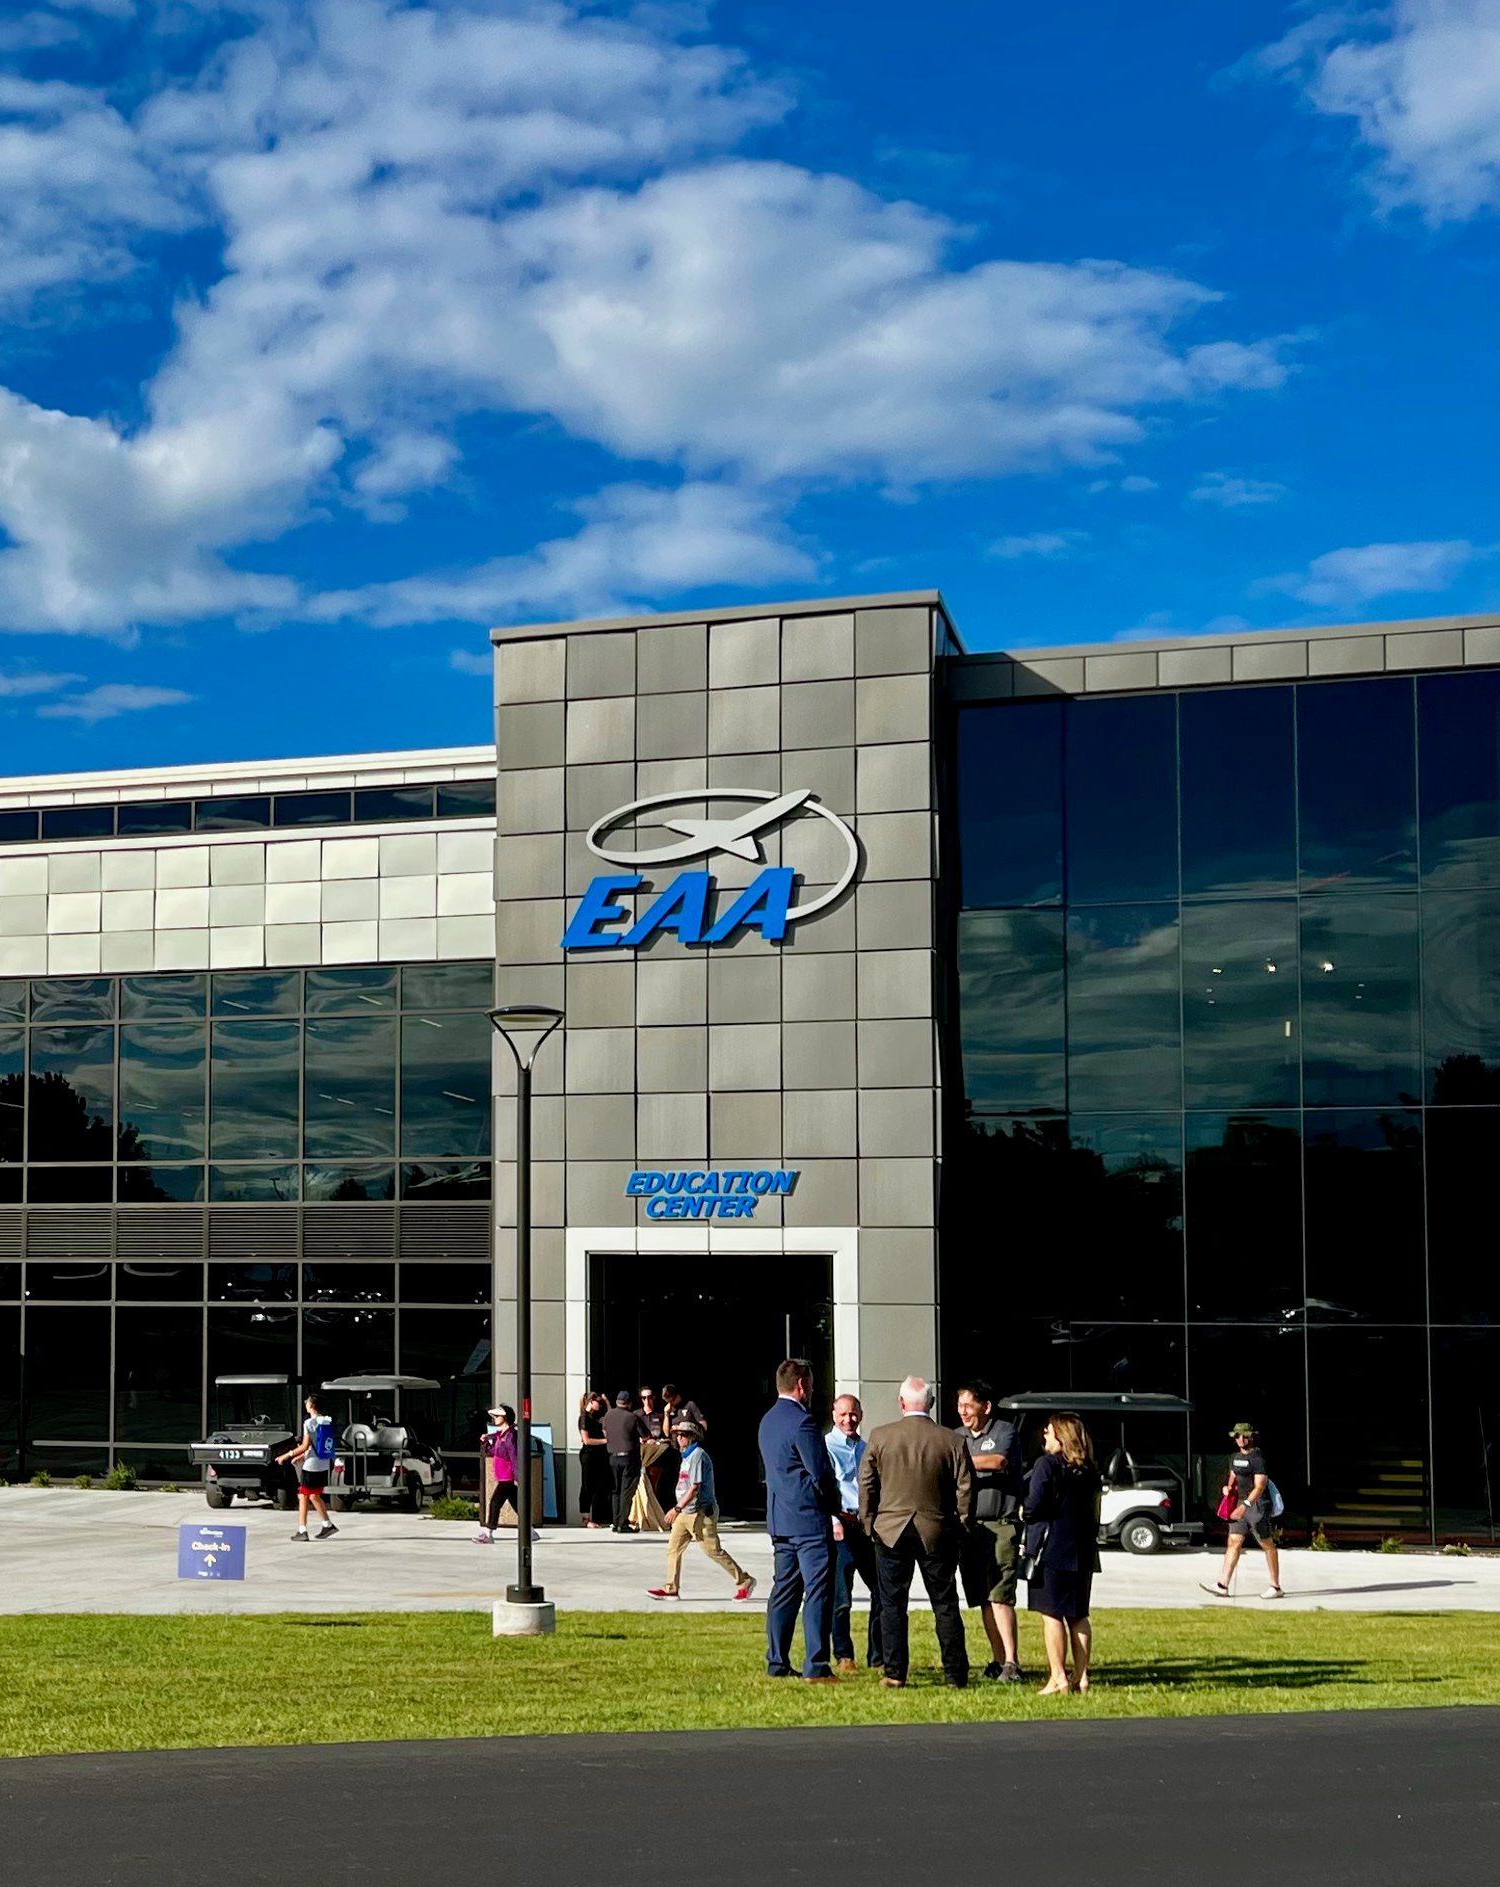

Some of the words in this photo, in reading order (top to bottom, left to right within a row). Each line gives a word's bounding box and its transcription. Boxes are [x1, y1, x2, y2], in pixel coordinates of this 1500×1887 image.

[561, 867, 795, 948] EAA
[625, 1170, 797, 1195] EDUCATION
[646, 1195, 758, 1218] CENTER
[191, 1541, 231, 1552] Check-in
